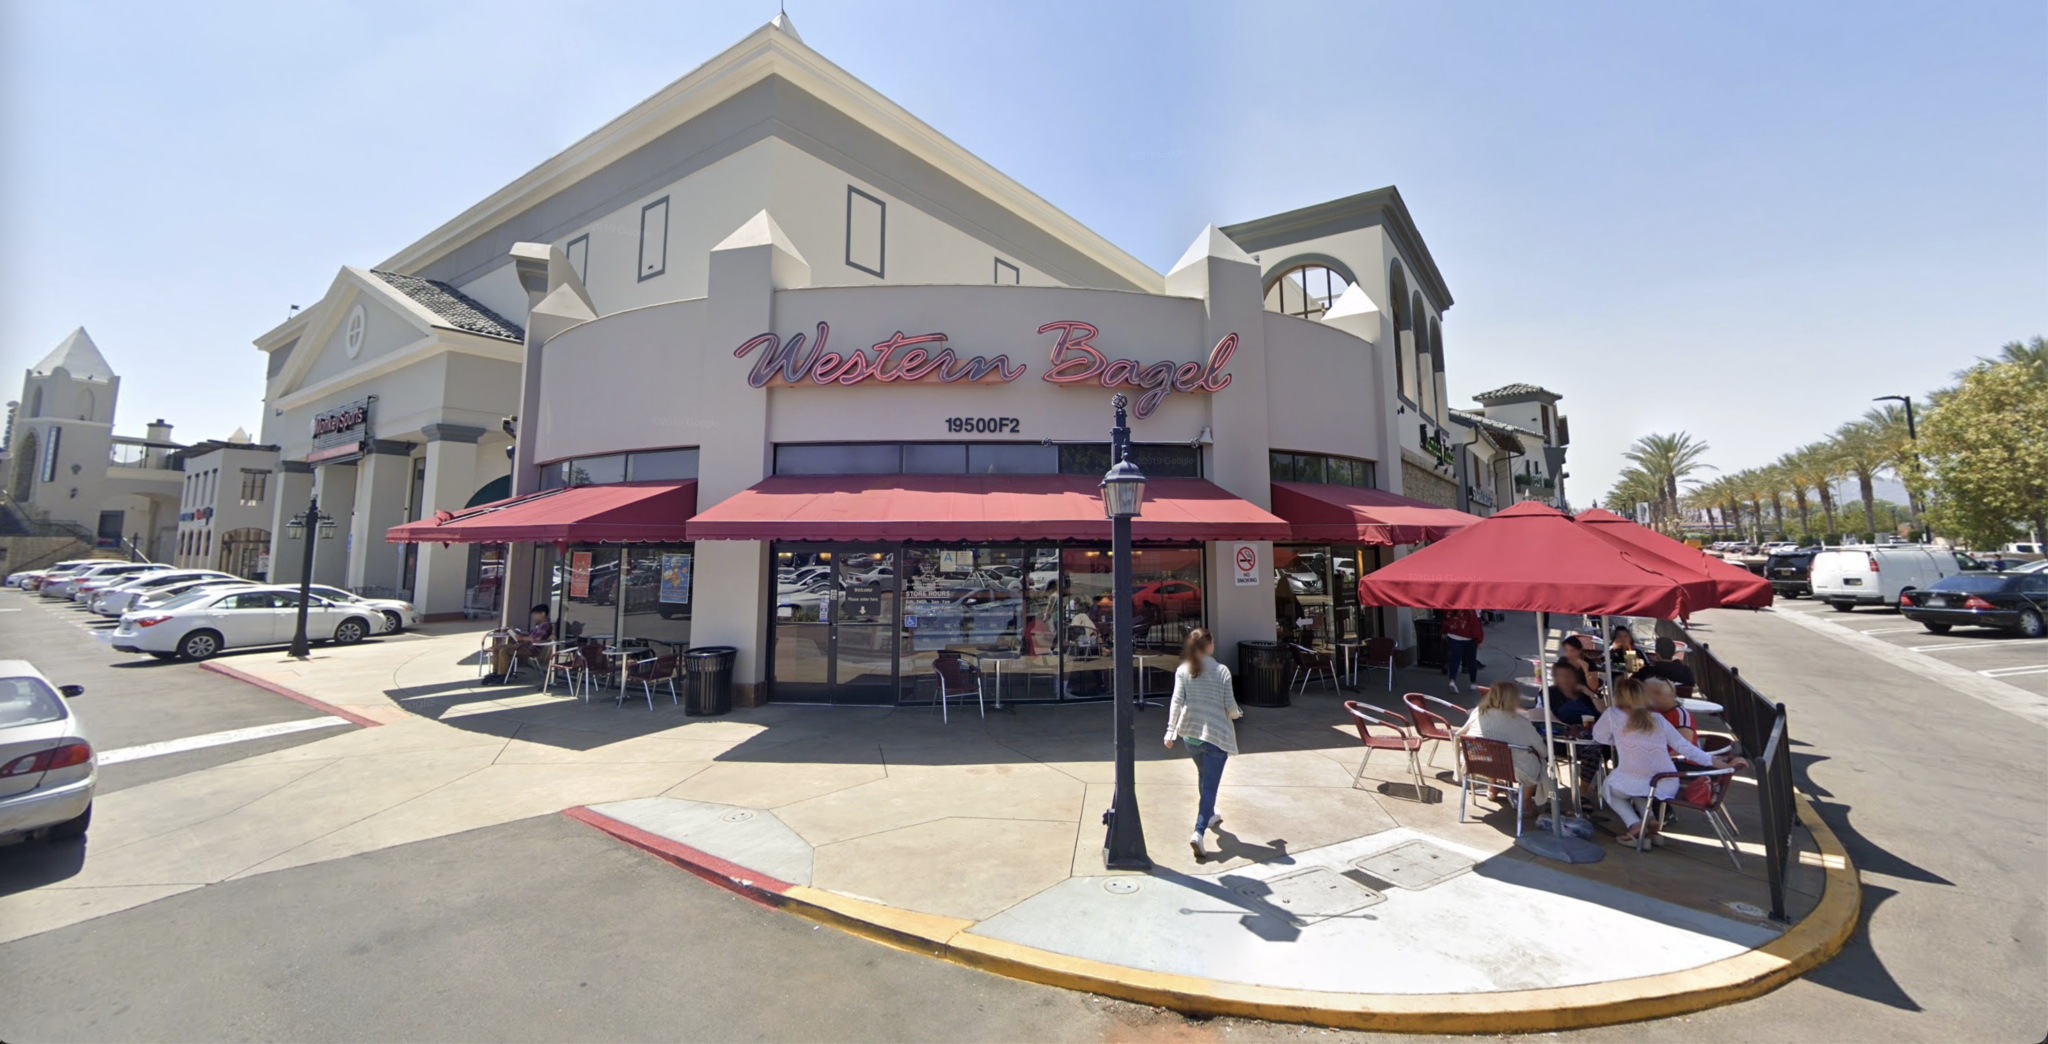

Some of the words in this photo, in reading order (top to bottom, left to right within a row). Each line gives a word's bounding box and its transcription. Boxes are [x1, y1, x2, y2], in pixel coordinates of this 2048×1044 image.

[733, 321, 1027, 389] Western
[1036, 320, 1239, 419] Bagel
[945, 416, 1020, 434] 19500F2
[943, 552, 953, 562] A
